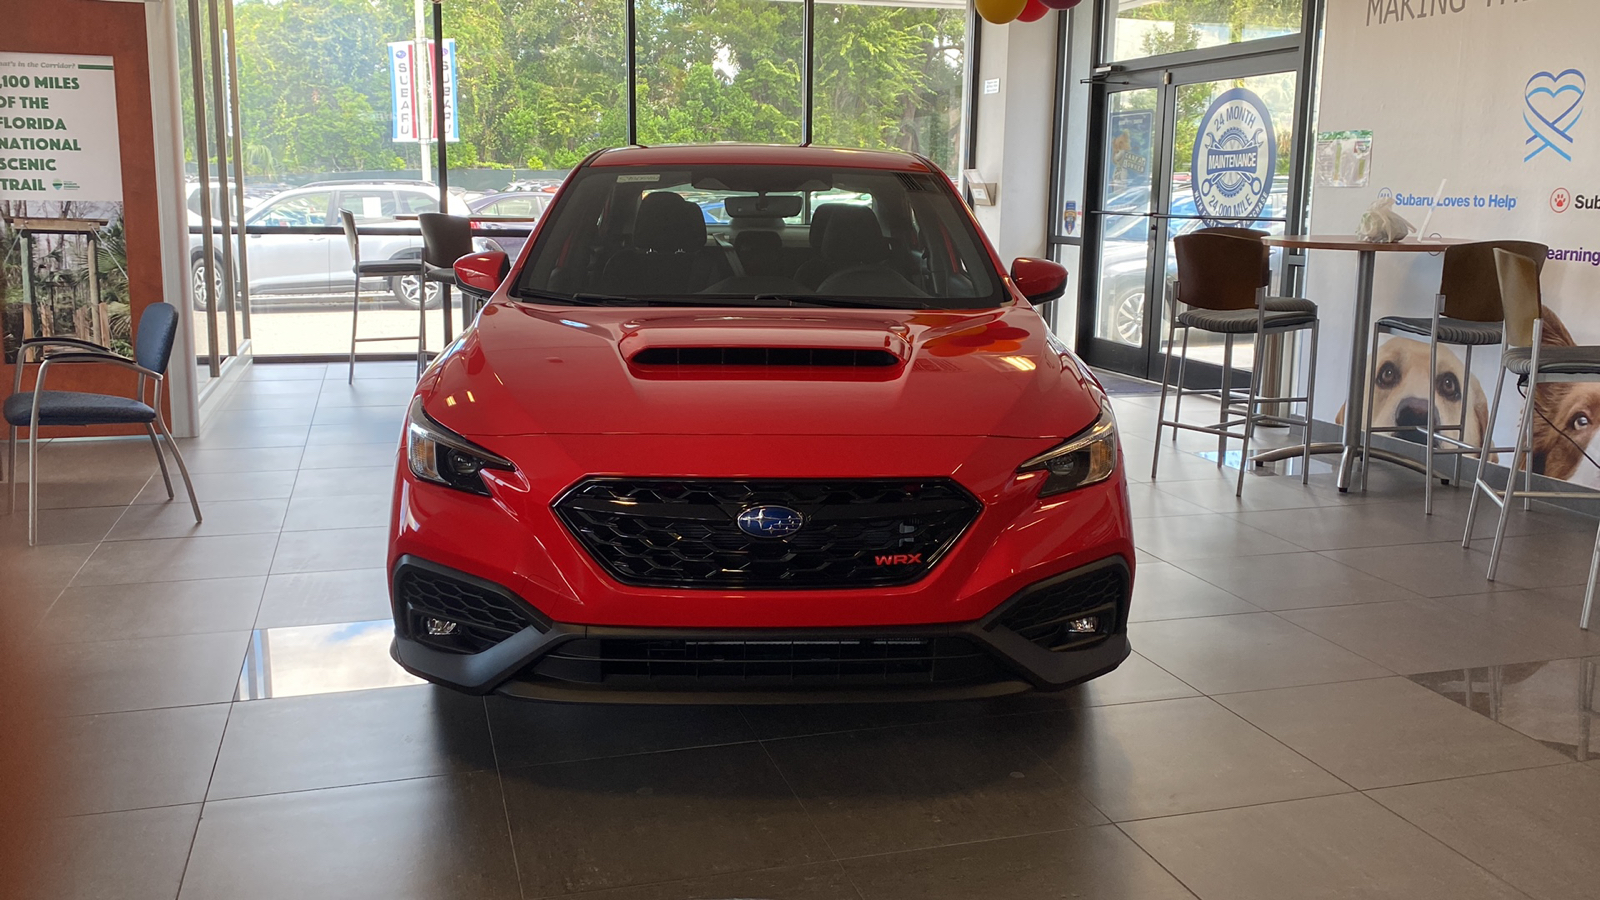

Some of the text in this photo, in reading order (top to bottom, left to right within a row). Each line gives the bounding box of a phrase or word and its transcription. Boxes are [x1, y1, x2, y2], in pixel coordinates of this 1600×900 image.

[34, 76, 80, 89] MILES
[0, 96, 49, 109] OF THE
[1214, 106, 1256, 131] 24 MONTH
[0, 137, 81, 151] NATIONAL
[0, 158, 57, 171] SCENIC
[1208, 152, 1257, 170] MAINTENANCE
[0, 178, 46, 191] TRAIL
[1234, 194, 1253, 216] MILE
[1395, 193, 1434, 207] Subaru
[1473, 195, 1485, 208] to
[1488, 194, 1517, 211] Help
[1574, 194, 1600, 209] Sub
[1546, 246, 1600, 266] earning
[874, 553, 922, 566] WRX
